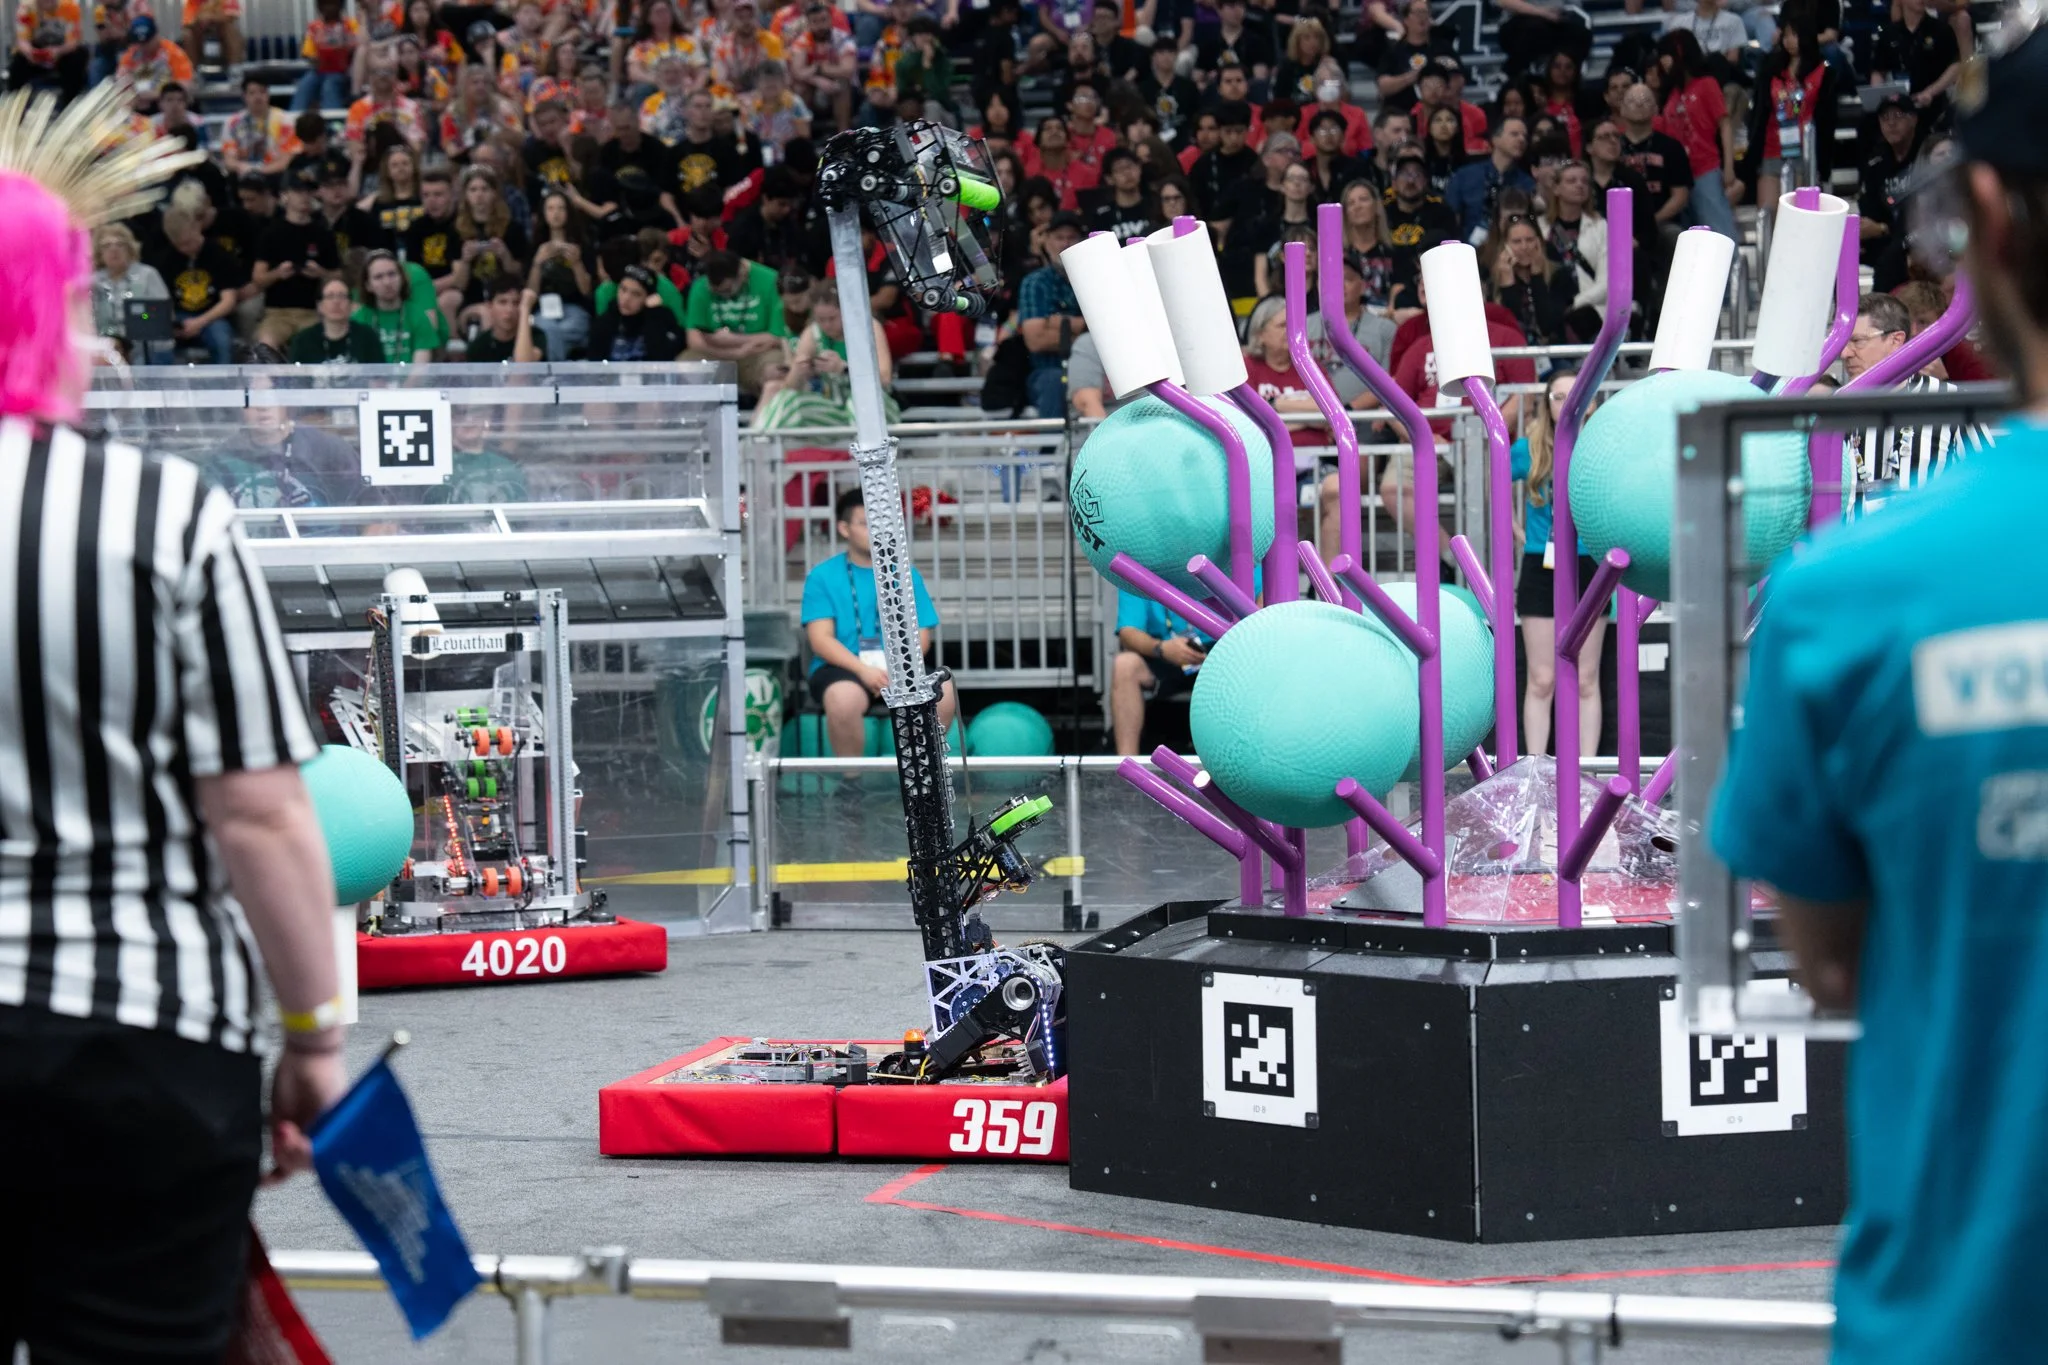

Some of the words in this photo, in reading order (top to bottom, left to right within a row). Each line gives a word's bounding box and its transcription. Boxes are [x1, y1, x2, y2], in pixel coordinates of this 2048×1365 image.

[431, 634, 504, 651] Leviathan
[461, 935, 567, 978] 4020
[949, 1098, 1058, 1156] 359
